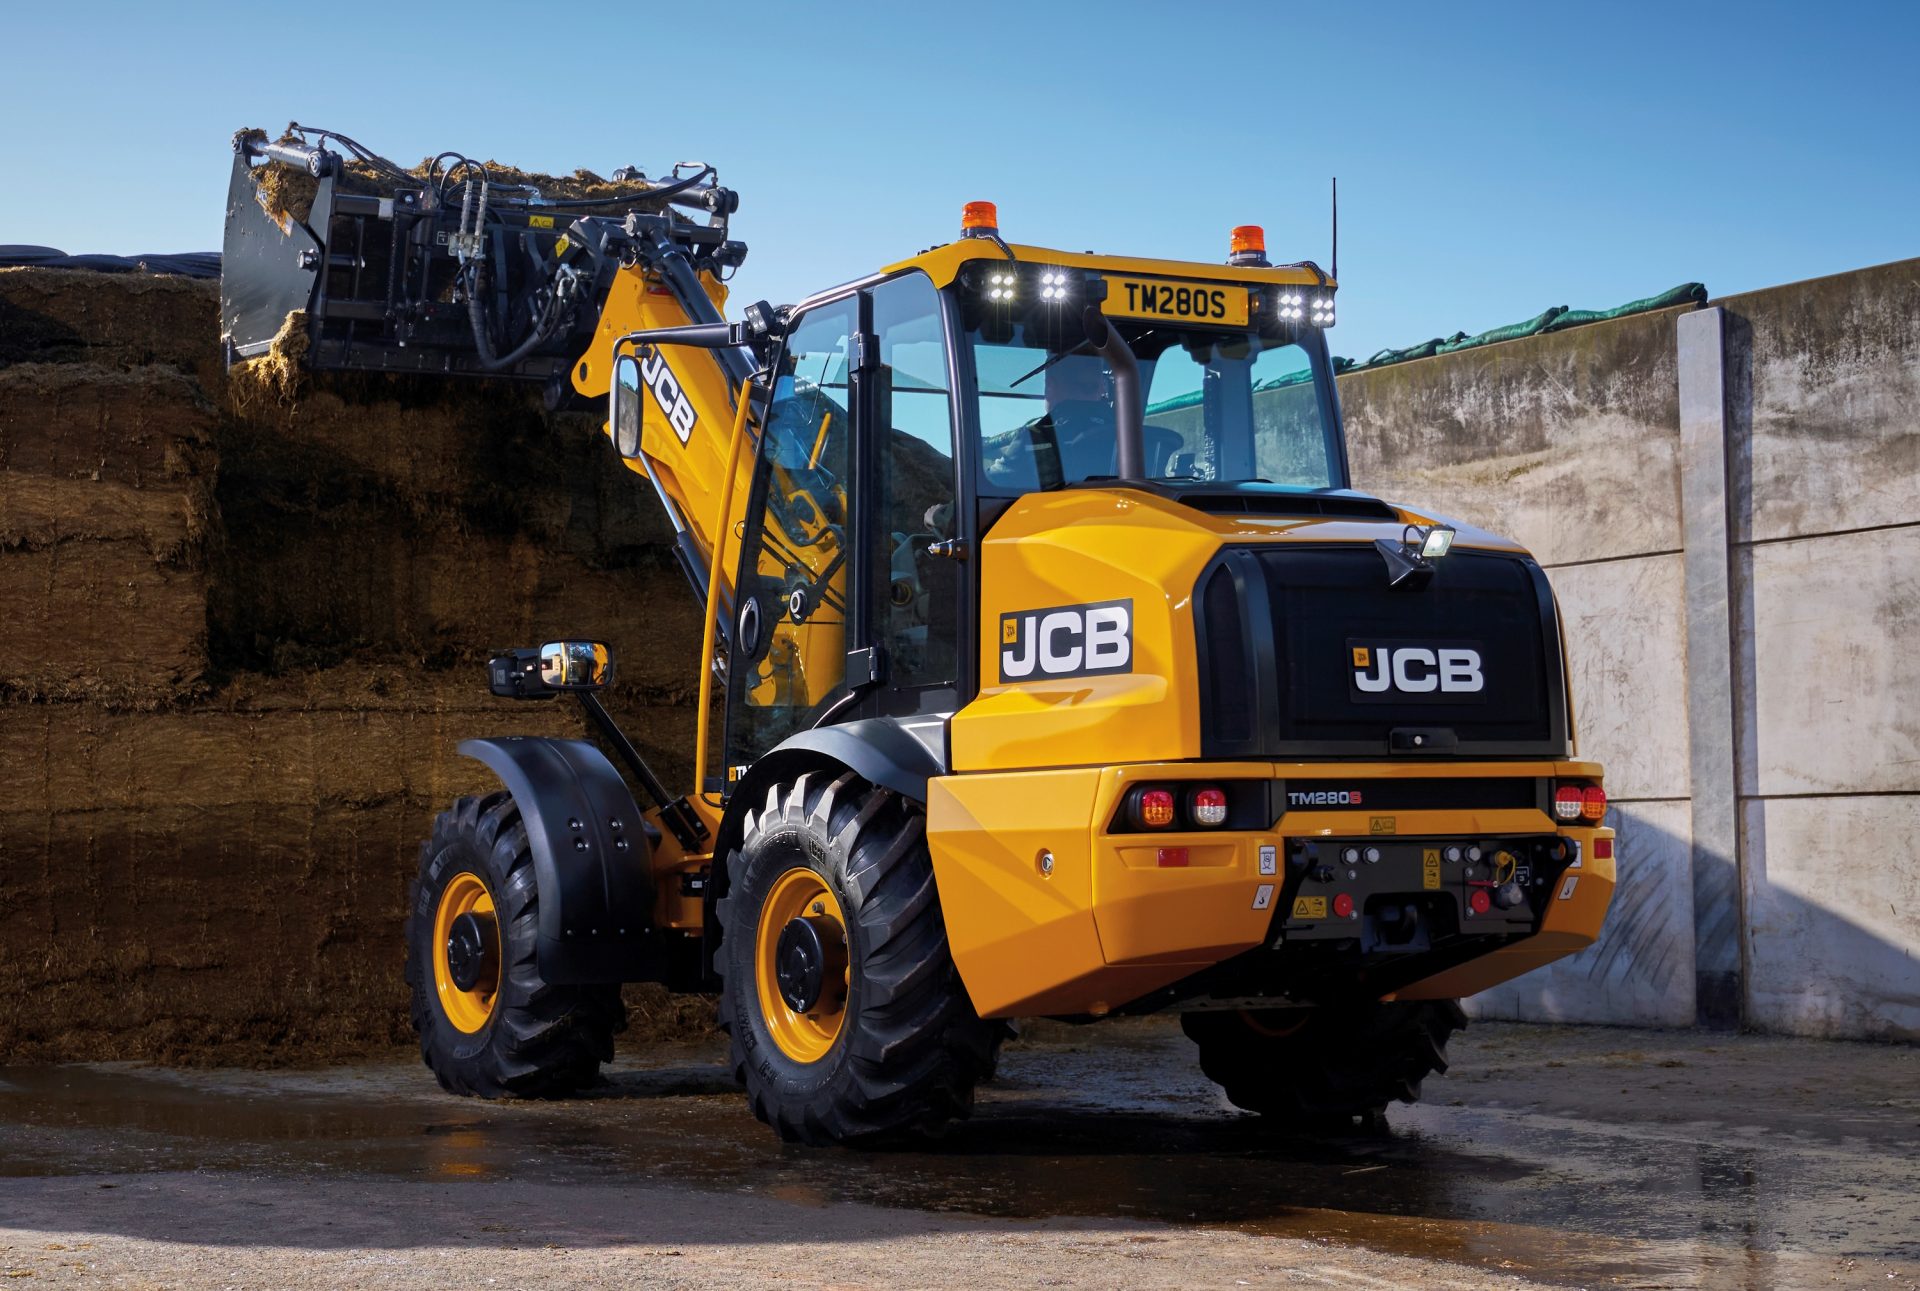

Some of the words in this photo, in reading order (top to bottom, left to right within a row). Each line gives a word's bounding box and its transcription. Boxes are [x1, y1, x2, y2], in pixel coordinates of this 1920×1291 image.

[1124, 283, 1225, 318] TM280S
[641, 354, 694, 443] JCB
[1003, 606, 1130, 677] JCB
[1354, 648, 1484, 693] JCB
[1287, 790, 1362, 805] TM280S
